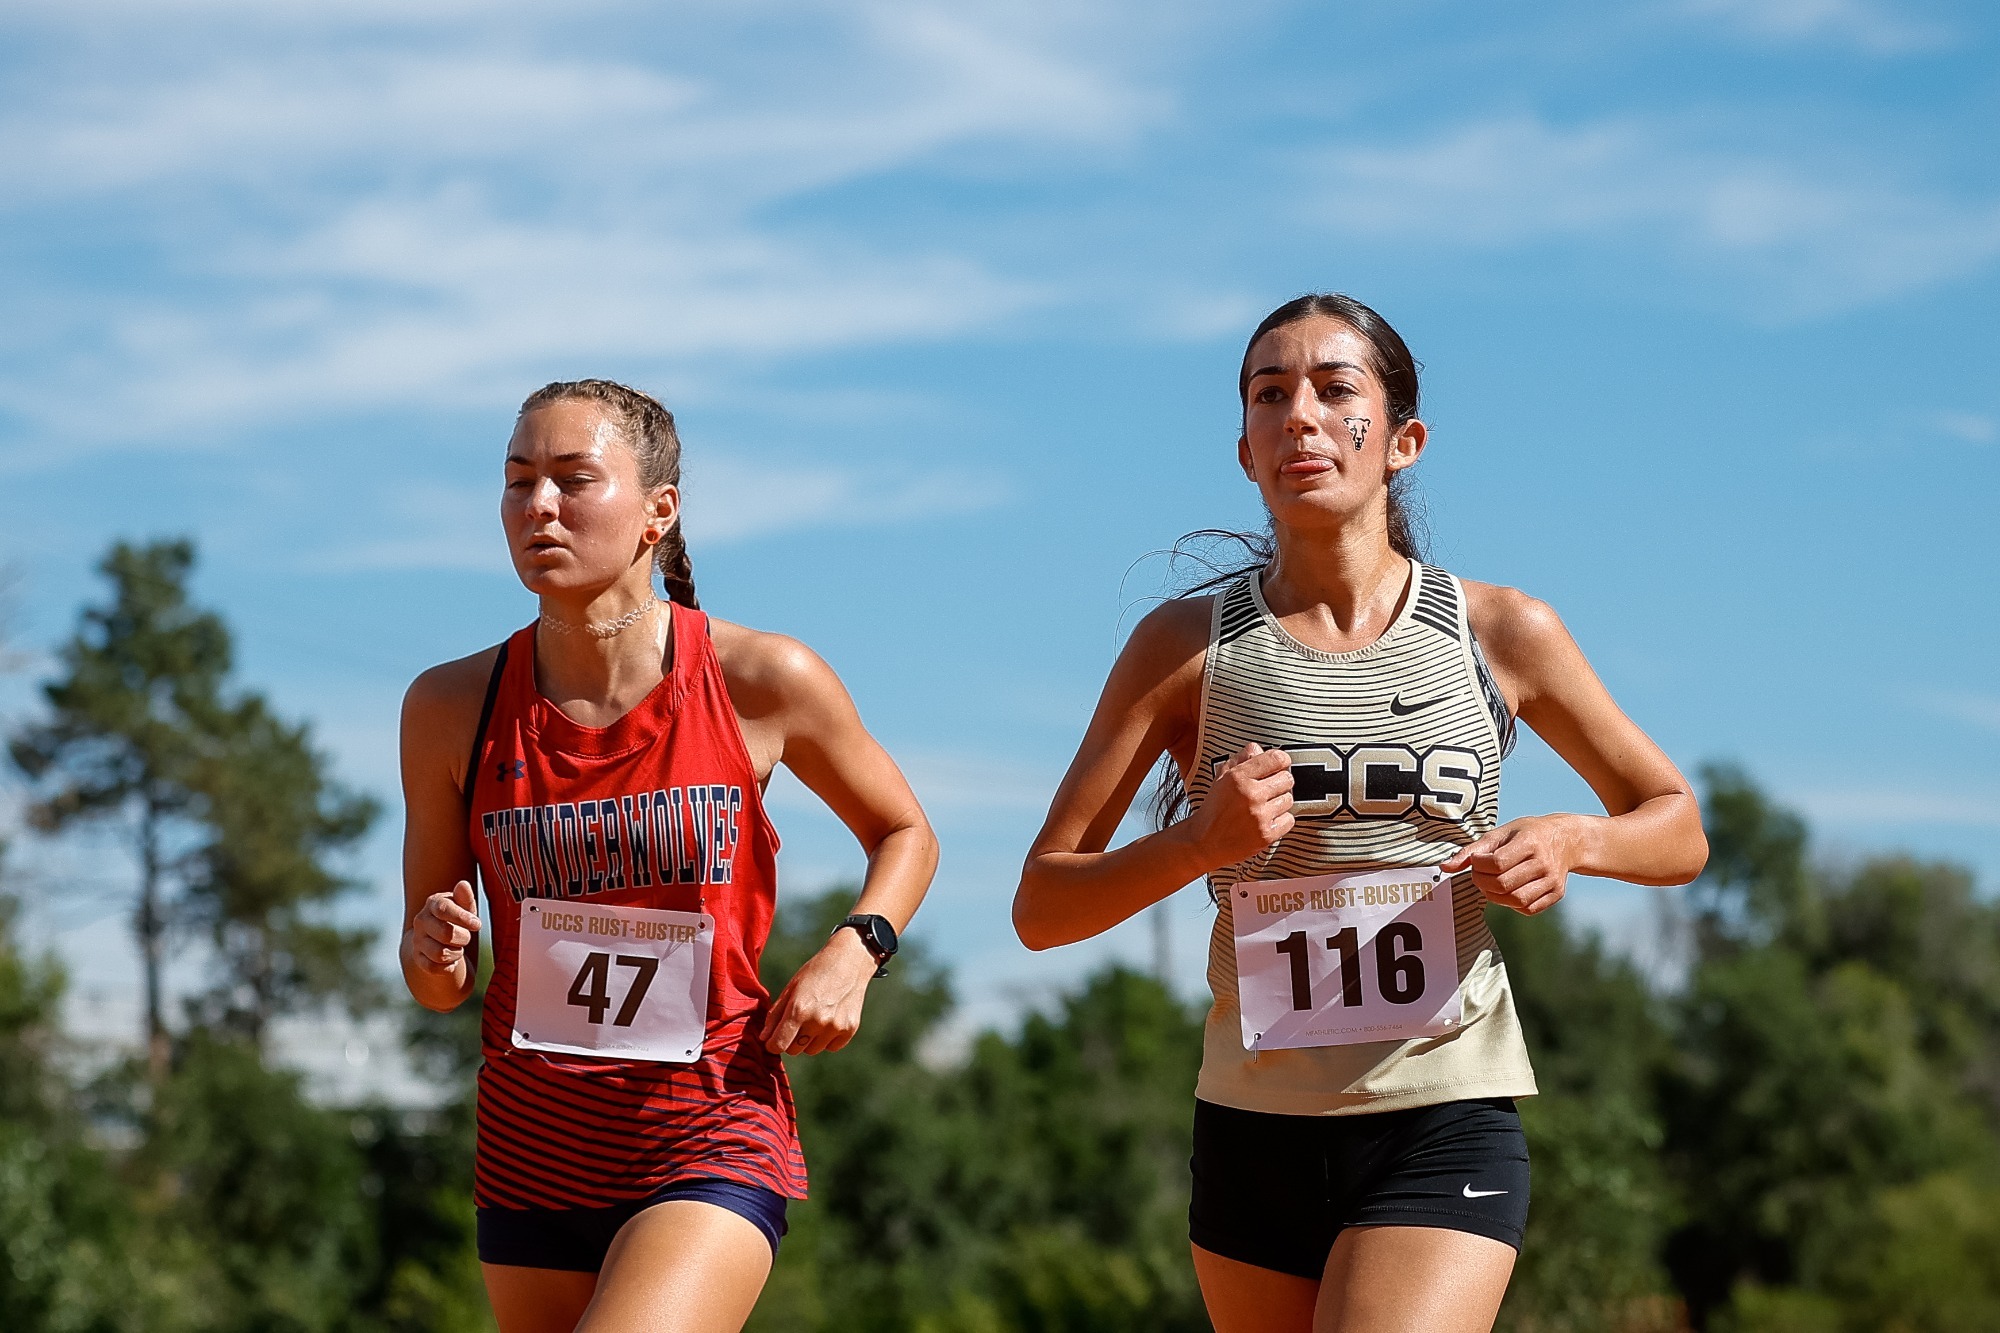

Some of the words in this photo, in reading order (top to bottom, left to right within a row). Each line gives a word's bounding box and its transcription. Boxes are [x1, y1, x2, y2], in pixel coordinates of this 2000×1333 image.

[1211, 743, 1483, 822] CCS
[482, 784, 742, 905] THUNDERWOLVES
[541, 912, 583, 934] UCCS
[588, 916, 697, 944] RUST-BUSTER
[1256, 893, 1305, 915] UCCS
[1310, 881, 1434, 911] RUST-BUSTER
[567, 951, 660, 1028] 47
[1275, 921, 1426, 1012] 116
